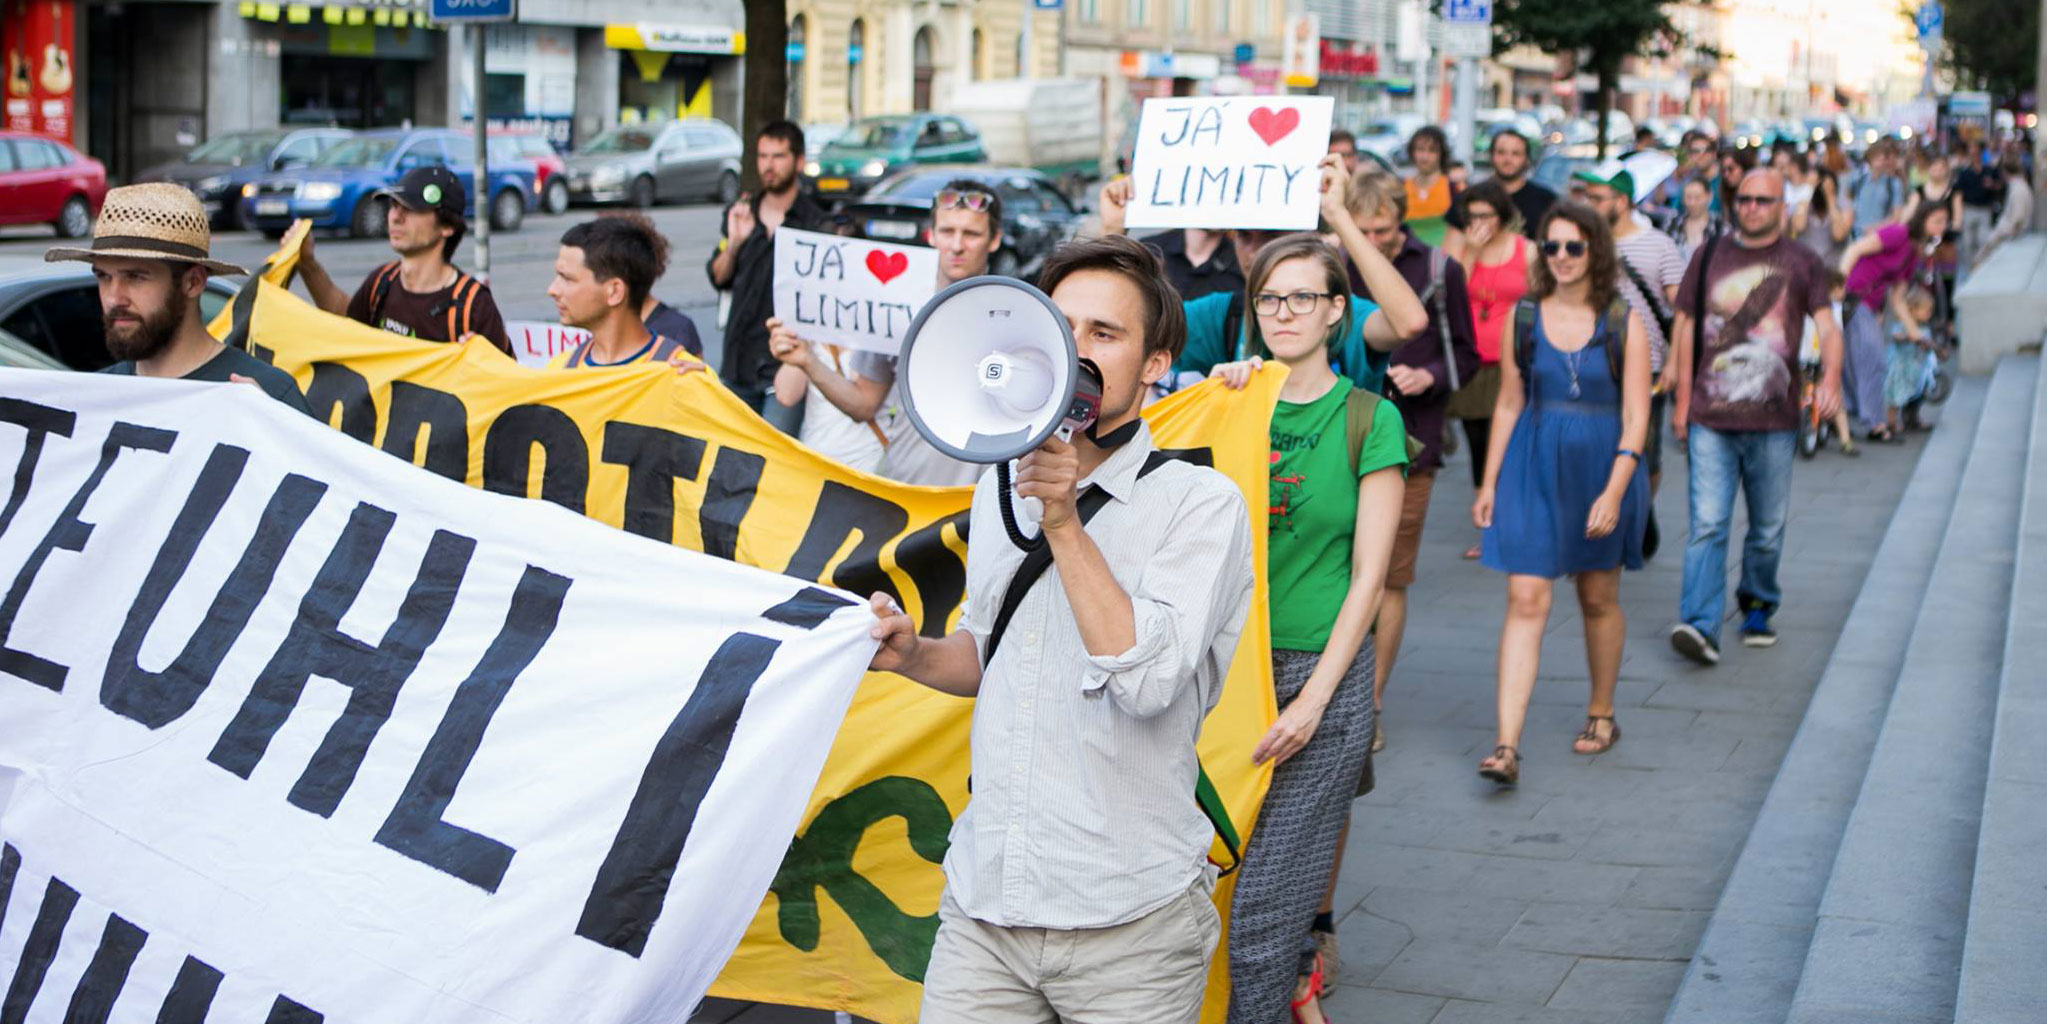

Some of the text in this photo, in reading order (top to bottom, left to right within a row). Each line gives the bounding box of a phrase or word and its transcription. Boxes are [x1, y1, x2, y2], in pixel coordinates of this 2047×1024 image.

[1161, 101, 1231, 147] JÁ
[1150, 163, 1304, 207] LIMITY
[794, 238, 849, 281] JÁ
[524, 327, 592, 358] LIM
